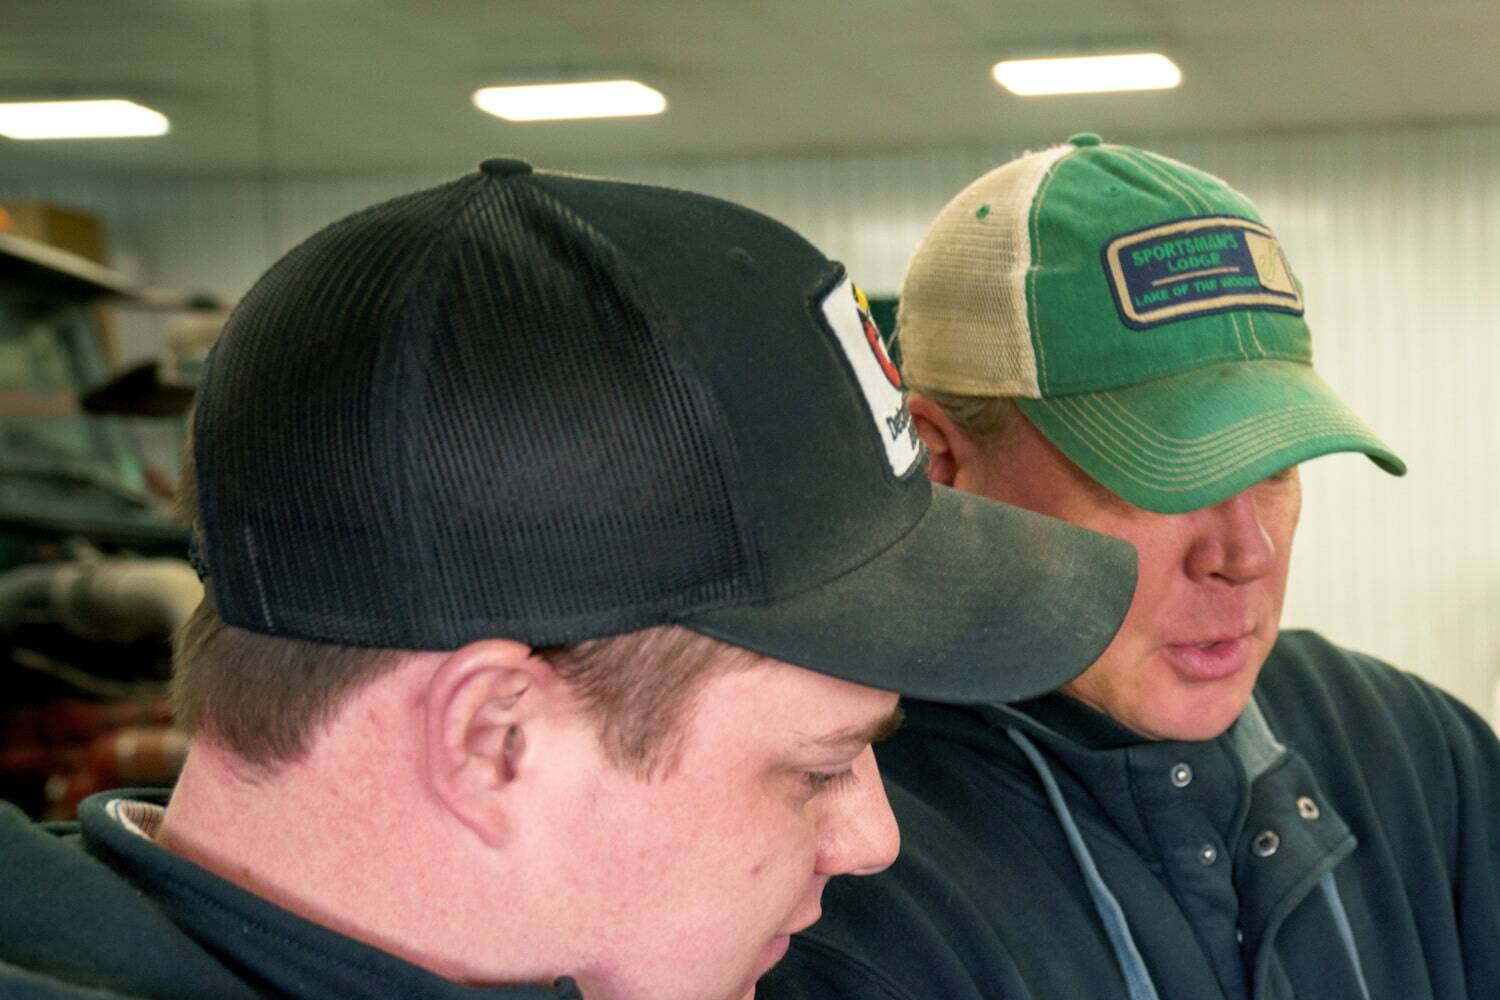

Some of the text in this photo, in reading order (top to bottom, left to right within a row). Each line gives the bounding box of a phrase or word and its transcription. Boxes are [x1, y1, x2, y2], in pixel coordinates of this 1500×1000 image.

[1168, 252, 1221, 272] LODGE
[1134, 287, 1169, 308] LAKE
[1172, 282, 1189, 297] OF
[1194, 278, 1219, 293] THE
